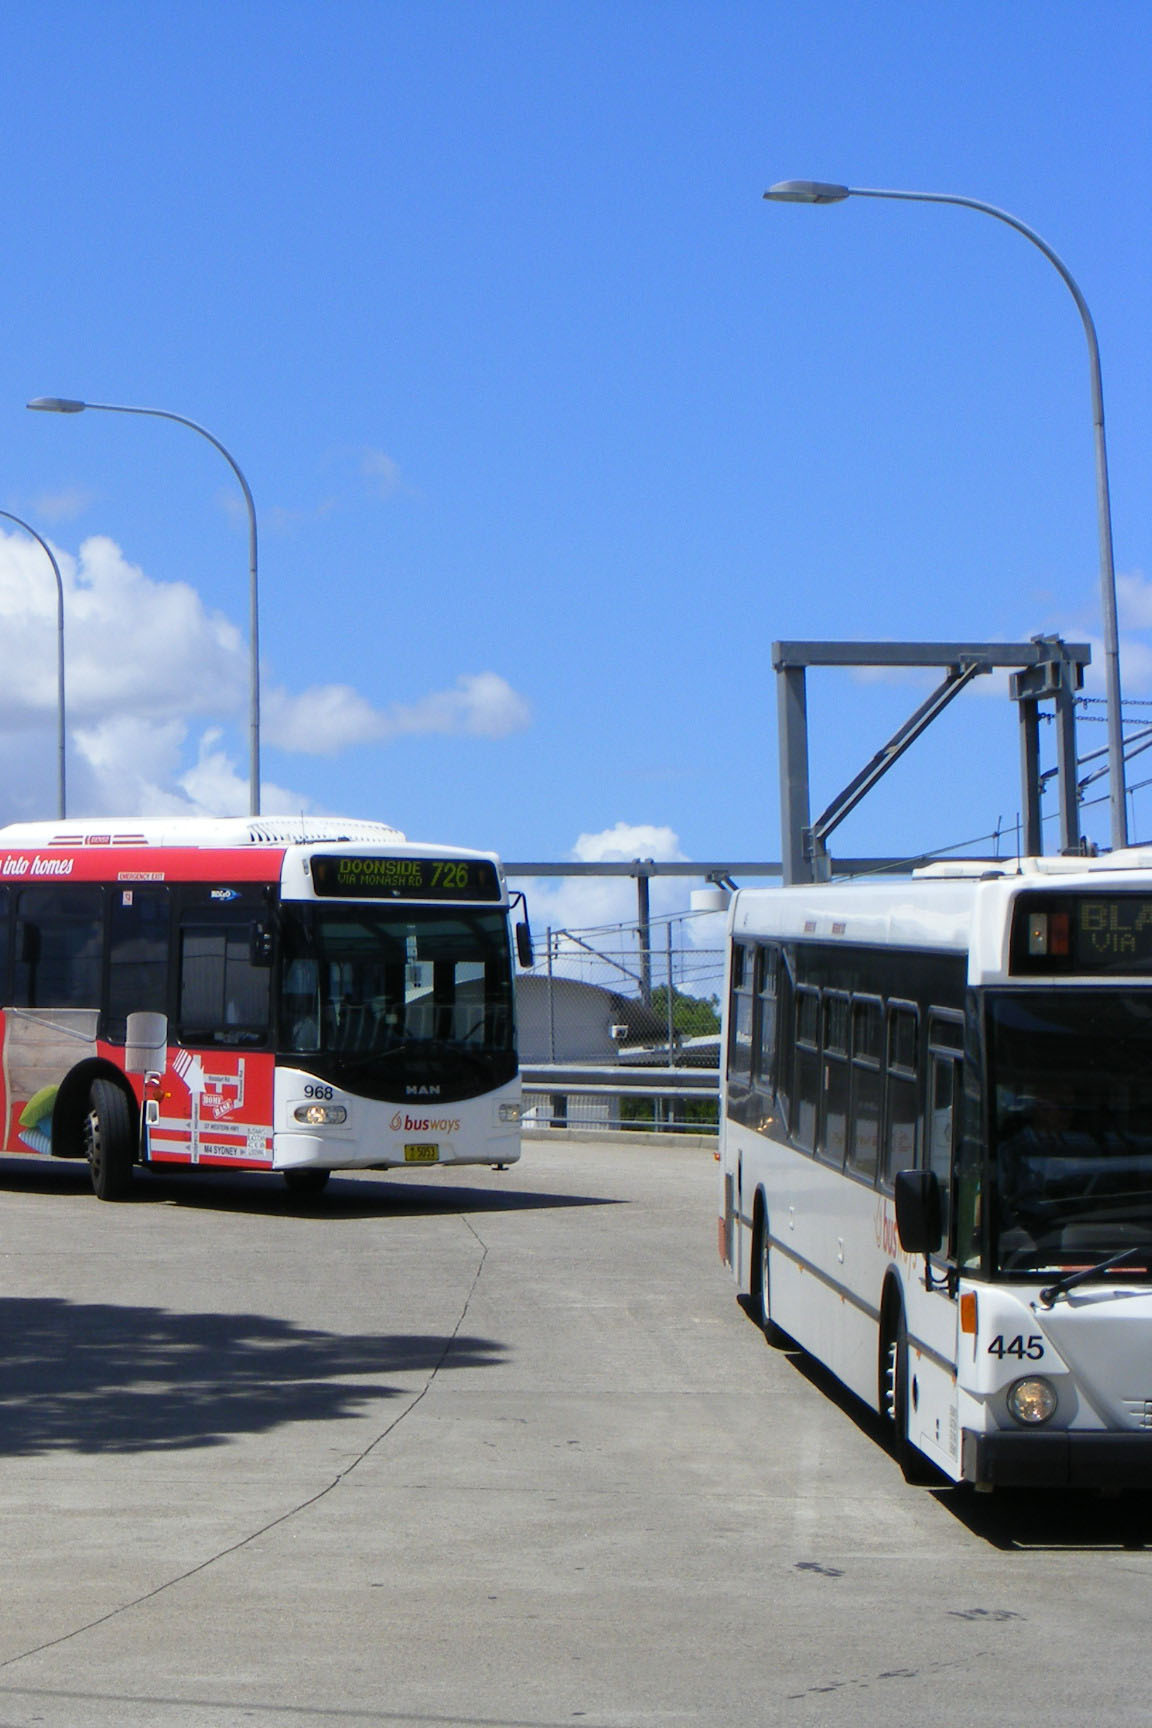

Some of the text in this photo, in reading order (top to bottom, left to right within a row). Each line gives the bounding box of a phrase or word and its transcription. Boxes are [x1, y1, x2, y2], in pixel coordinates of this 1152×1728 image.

[2, 855, 29, 876] into
[30, 855, 74, 876] homes
[339, 859, 469, 888] DOONSIDE 726
[337, 874, 423, 887] VIA MONASH RD
[1091, 933, 1136, 952] VIA
[303, 1084, 334, 1100] 968
[405, 1085, 441, 1095] MAN
[404, 1114, 460, 1134] busways
[213, 1146, 237, 1155] SYDNEY
[987, 1335, 1045, 1360] 445
